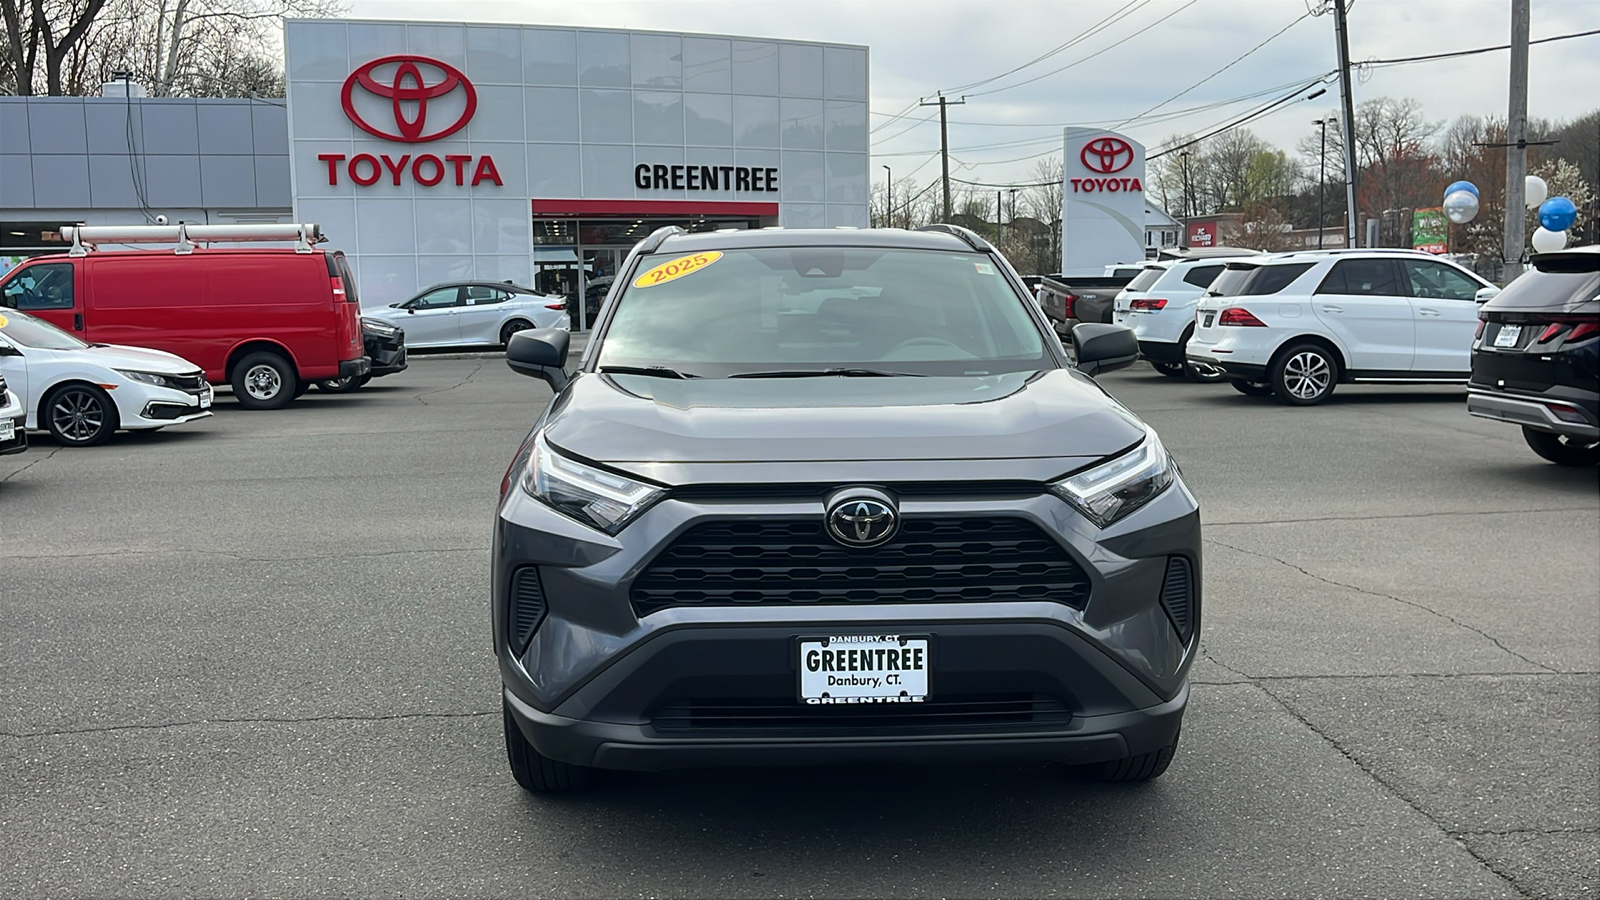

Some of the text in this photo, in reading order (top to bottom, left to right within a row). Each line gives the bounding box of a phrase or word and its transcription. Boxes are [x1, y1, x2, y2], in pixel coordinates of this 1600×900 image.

[318, 153, 504, 187] TOYOTA
[635, 164, 778, 192] GREENTREE
[1070, 178, 1143, 193] TOYOTA
[651, 254, 708, 283] 2025
[829, 635, 883, 644] DANBURY,
[806, 648, 923, 672] GREENTREE
[828, 673, 902, 689] Danbury, CT.
[806, 696, 925, 705] GREENTREE
